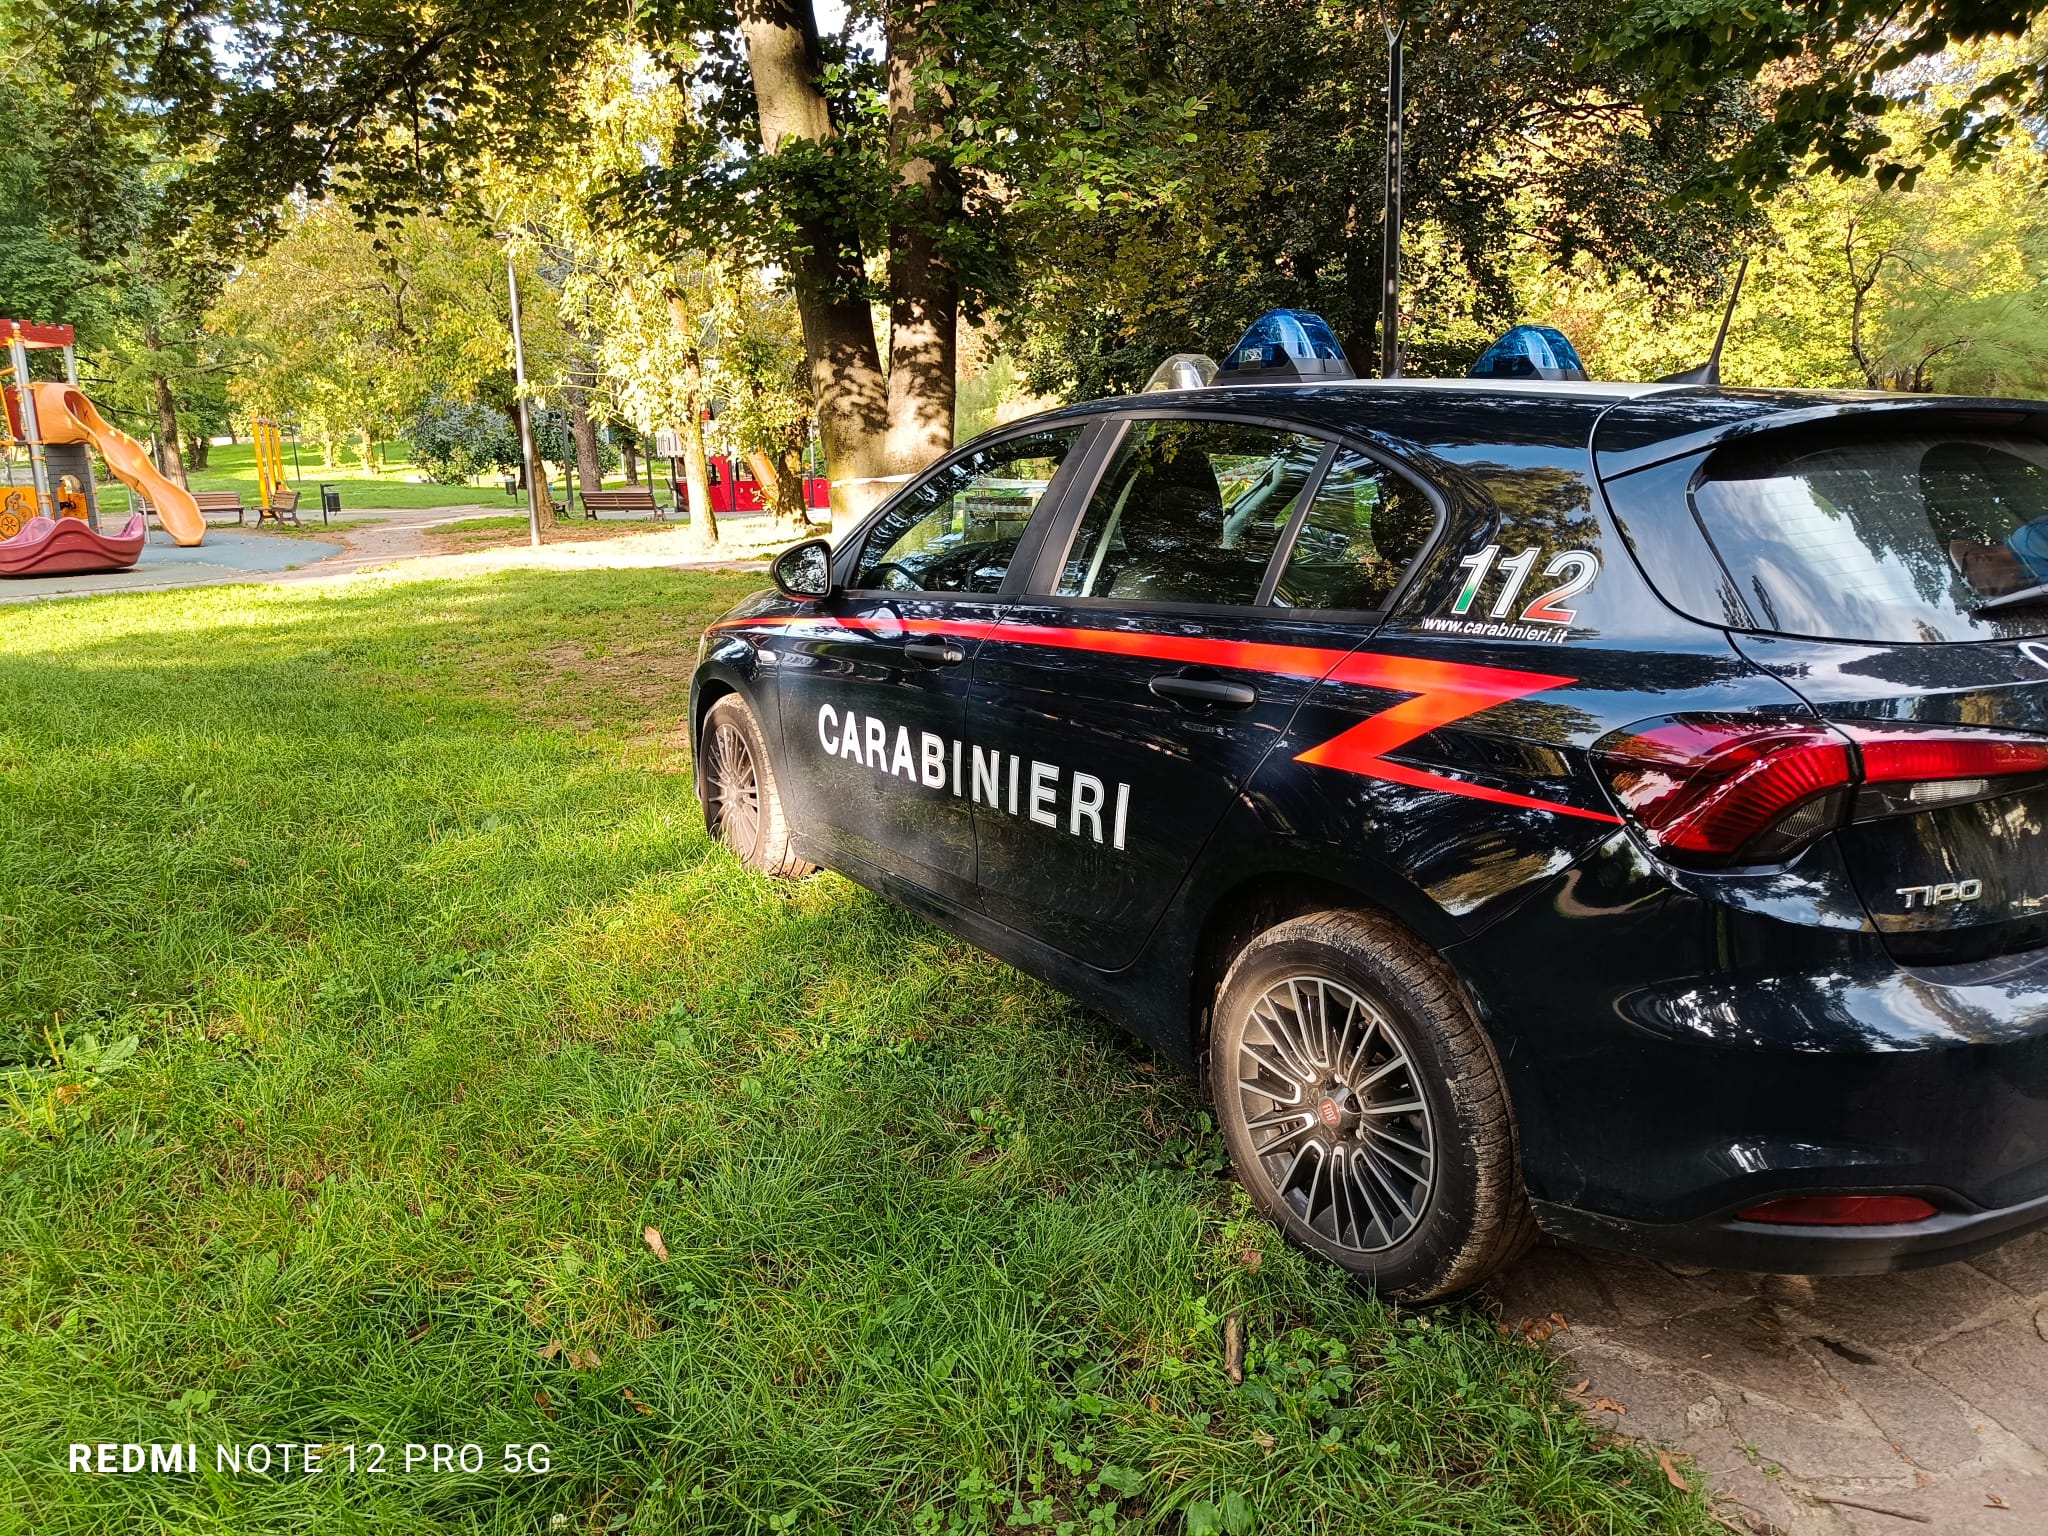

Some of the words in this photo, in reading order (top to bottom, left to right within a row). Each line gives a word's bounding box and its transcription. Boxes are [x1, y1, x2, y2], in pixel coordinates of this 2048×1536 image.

[1451, 545, 1599, 625] 112
[1422, 617, 1568, 644] www.carabinieri.it
[818, 703, 1131, 851] CARABINIERI
[1896, 879, 1982, 909] TIPO
[1321, 1103, 1337, 1121] FIAT
